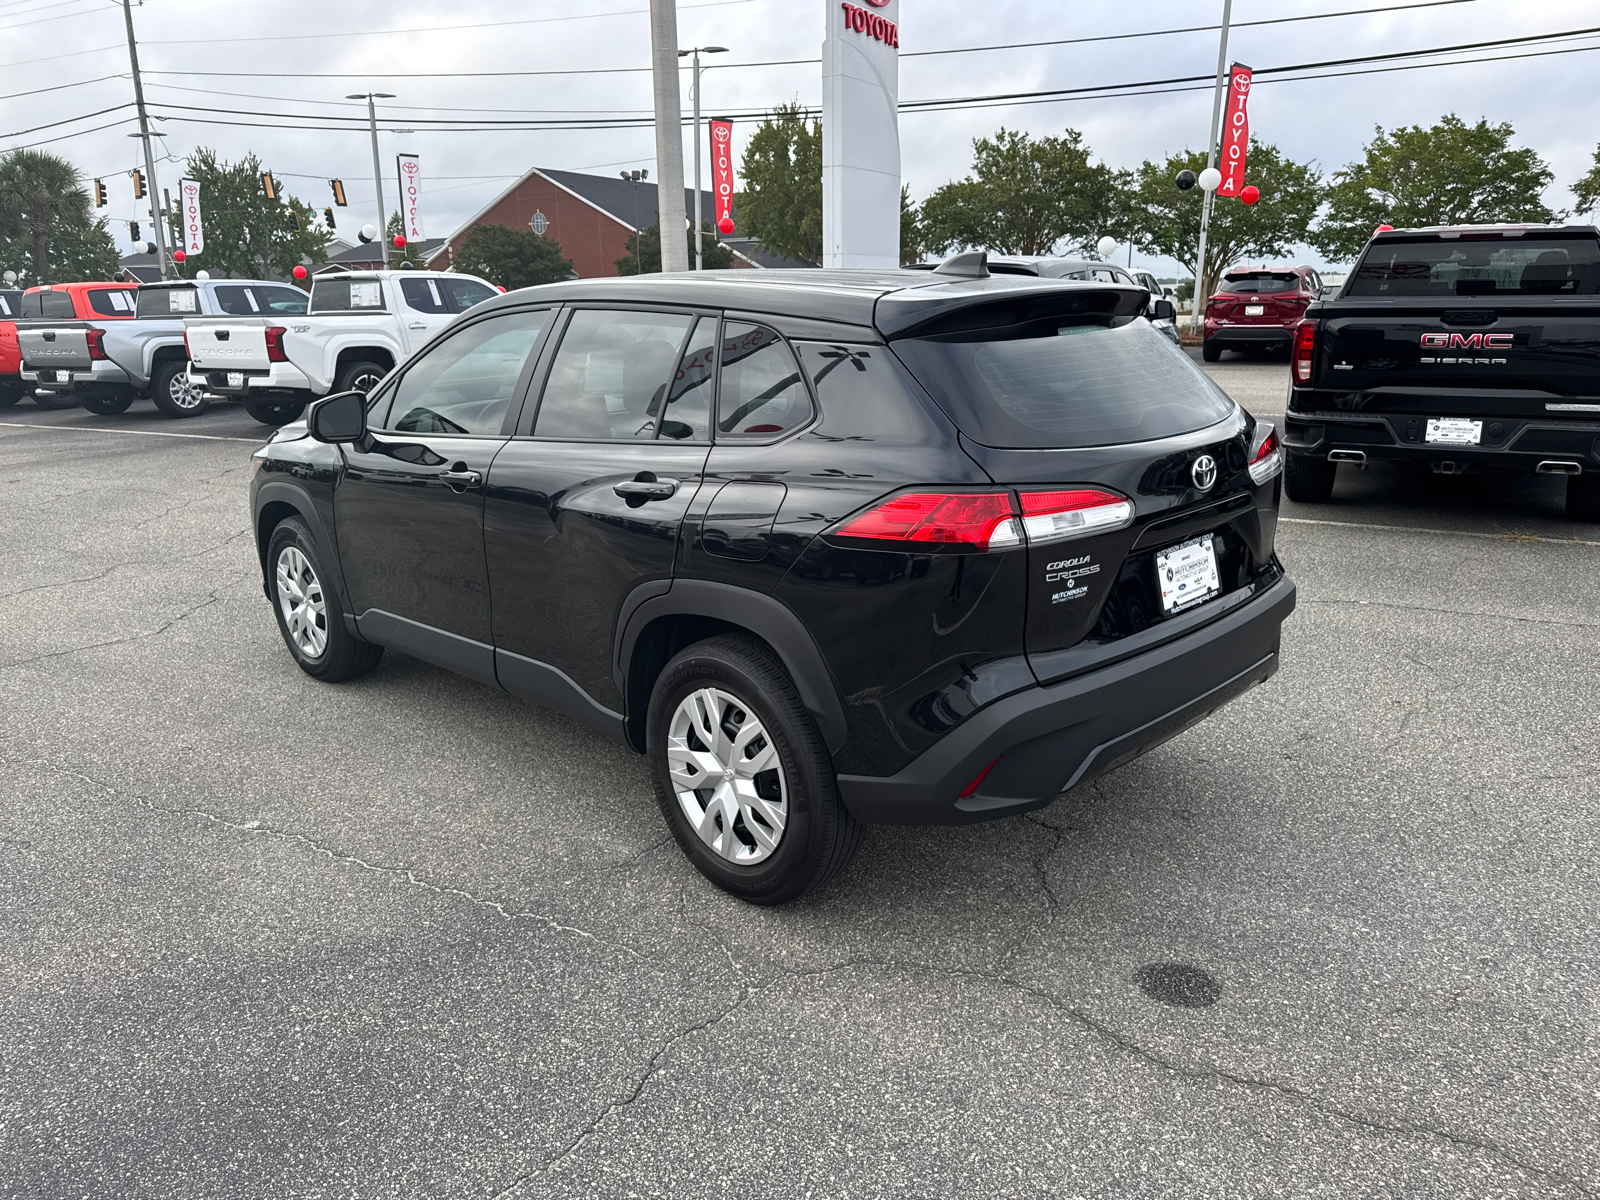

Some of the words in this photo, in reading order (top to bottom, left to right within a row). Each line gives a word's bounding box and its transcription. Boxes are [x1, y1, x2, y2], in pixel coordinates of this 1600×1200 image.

[841, 2, 899, 49] TOYOTA
[1222, 94, 1246, 191] TOYOTA
[718, 144, 730, 219] TOYOTA
[407, 175, 419, 236] TOYOTA
[188, 197, 199, 250] TOYOTA
[1420, 333, 1514, 349] GMC
[1420, 357, 1507, 365] SIERRA
[1045, 564, 1100, 582] CROSS
[1046, 554, 1091, 570] COROLLA
[1174, 556, 1210, 577] HUTCHINSON
[1051, 585, 1088, 601] HUTCHINSON
[756, 698, 803, 790] Continental
